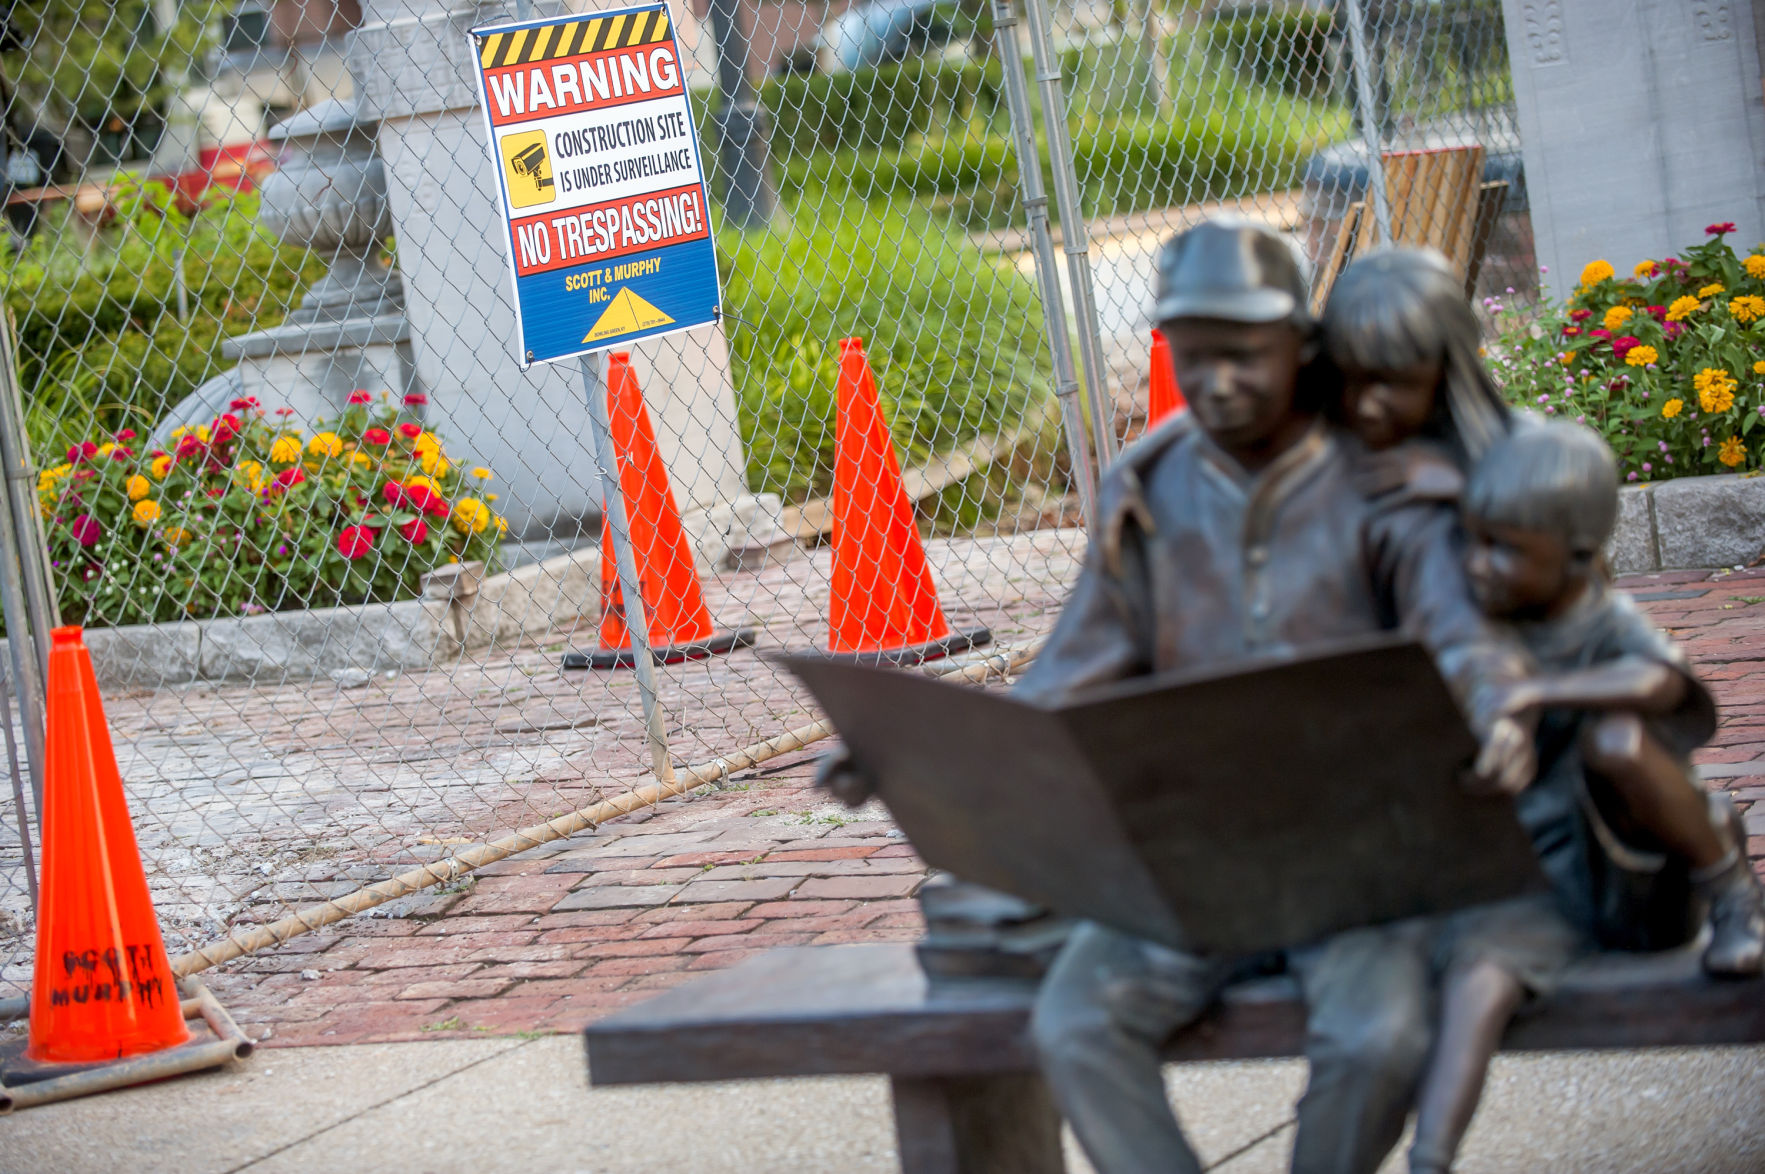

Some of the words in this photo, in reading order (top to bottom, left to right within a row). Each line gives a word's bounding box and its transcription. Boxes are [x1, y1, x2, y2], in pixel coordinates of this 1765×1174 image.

[488, 47, 680, 117] WARNING
[555, 117, 656, 159] CONSTRUCTION
[657, 112, 686, 140] SITE
[560, 171, 572, 192] IS
[573, 163, 613, 190] UNDER
[614, 148, 692, 182] SURVEILLANCE
[517, 221, 551, 268] NO
[552, 191, 703, 260] TRESPASSING!
[565, 269, 602, 292] SCOTT
[604, 268, 612, 283] &
[614, 257, 661, 281] MURPHY
[589, 286, 610, 304] INC.
